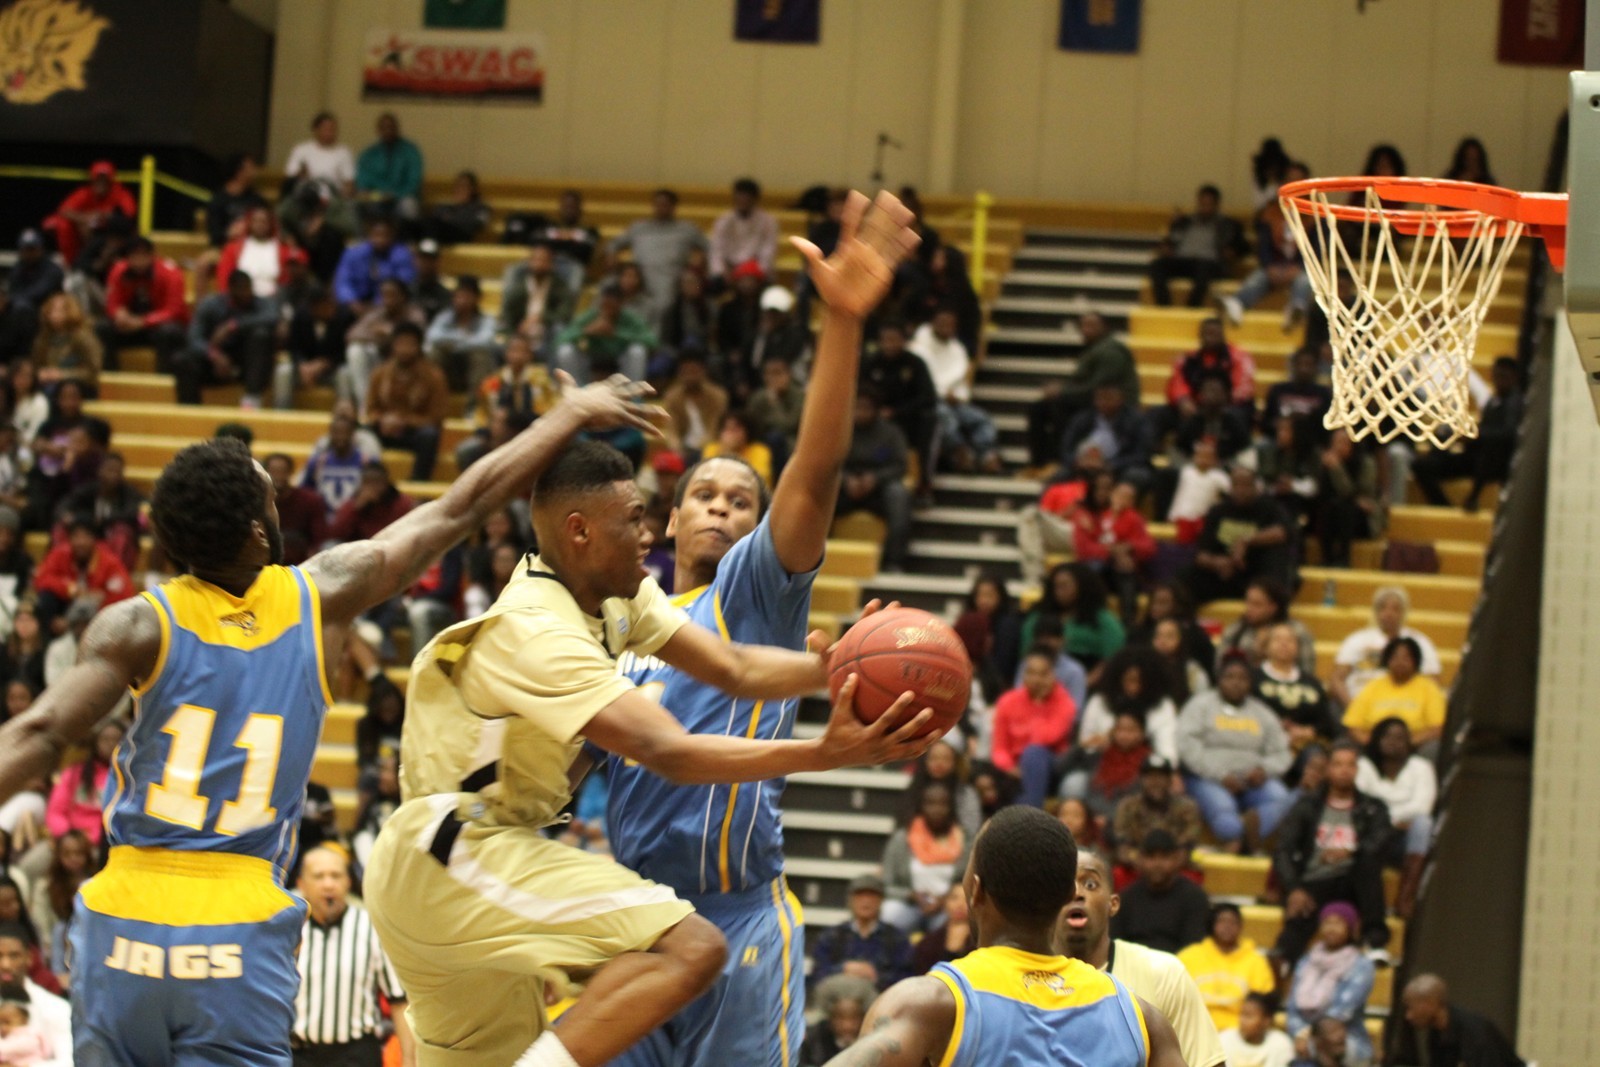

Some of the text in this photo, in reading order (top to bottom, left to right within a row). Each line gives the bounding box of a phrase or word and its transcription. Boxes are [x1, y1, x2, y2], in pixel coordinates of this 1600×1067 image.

[412, 45, 537, 81] SWAC
[144, 703, 285, 837] 11
[104, 935, 244, 980] JAGS
